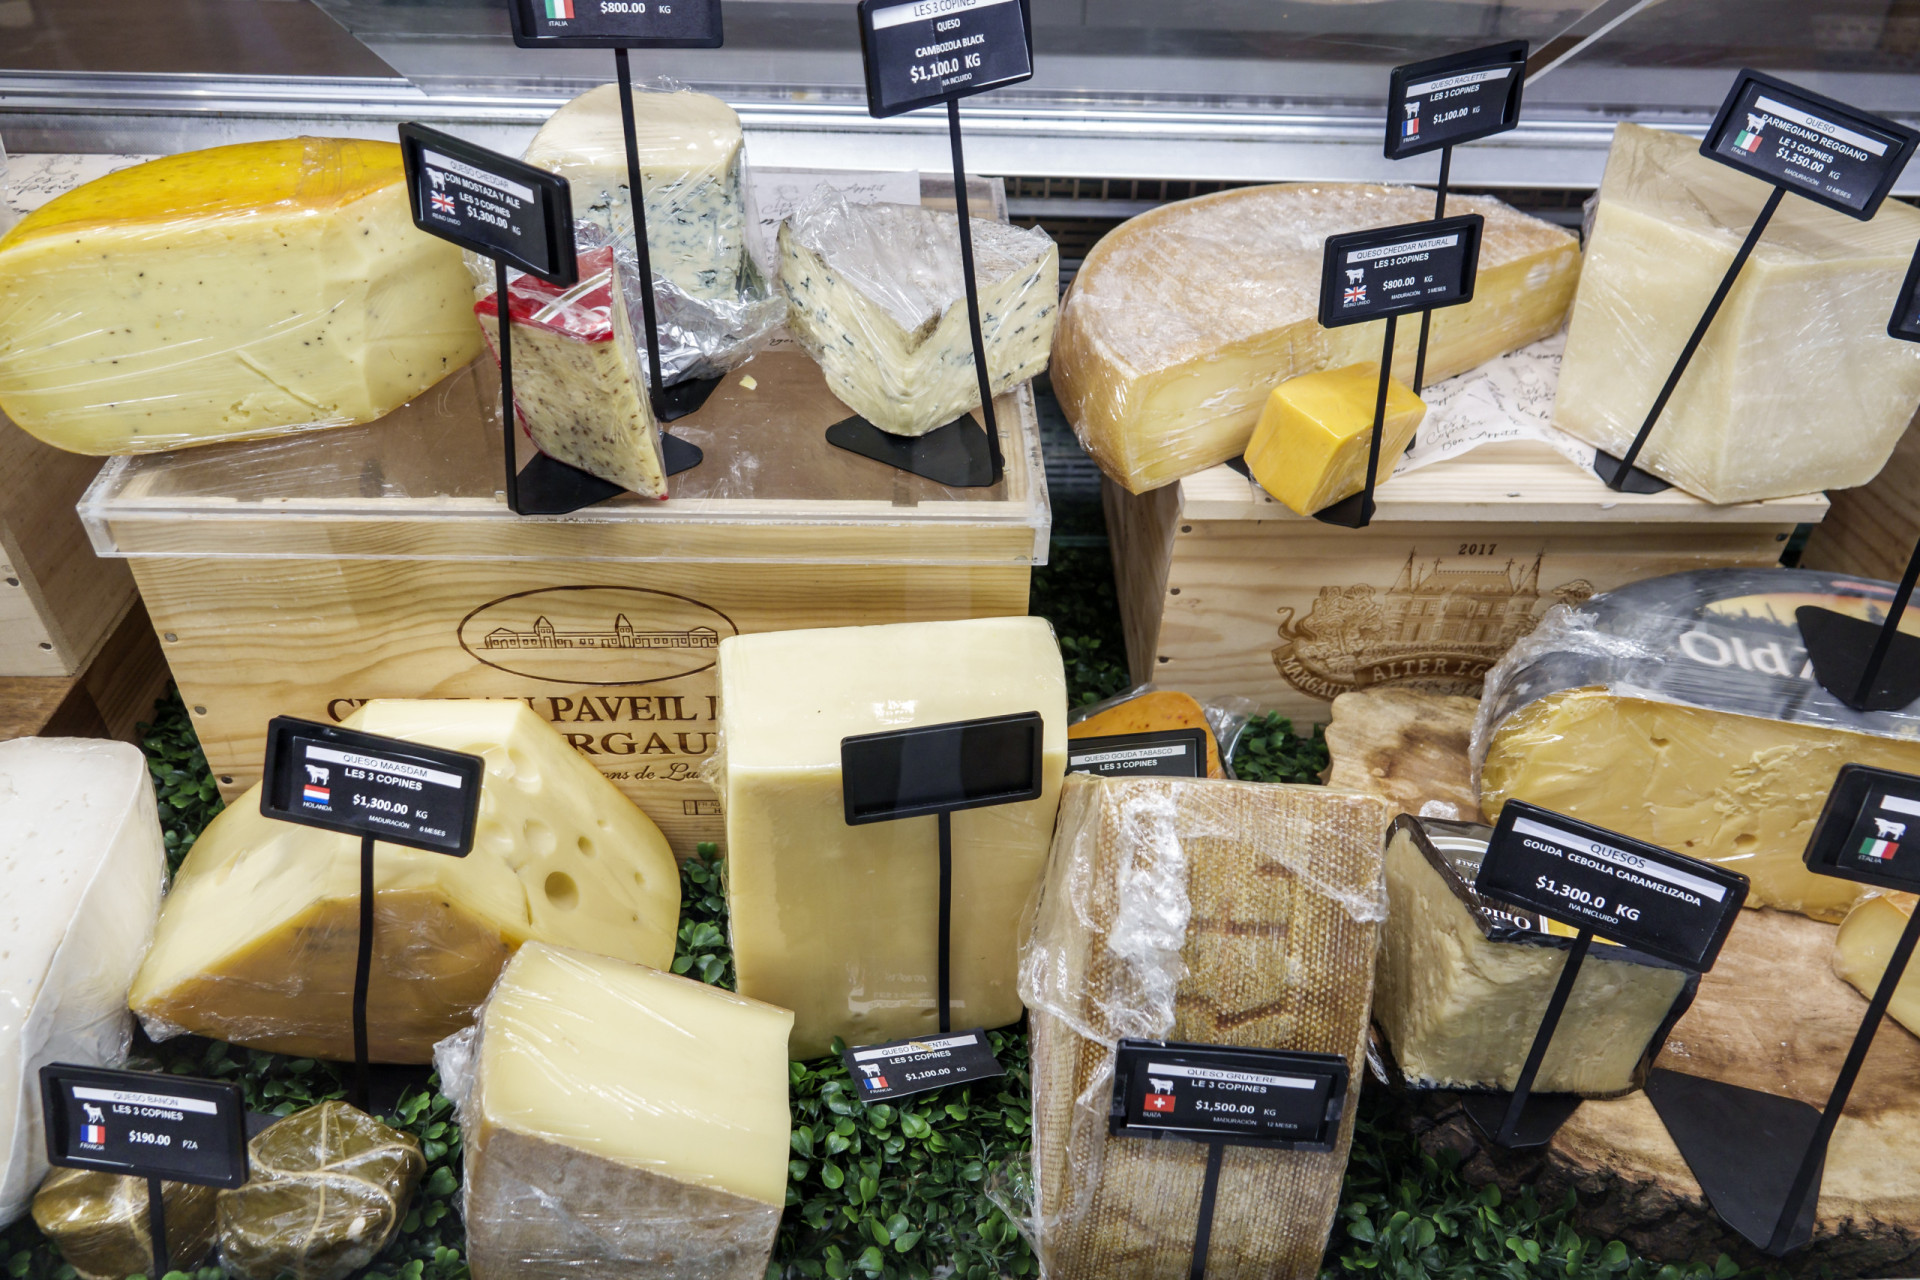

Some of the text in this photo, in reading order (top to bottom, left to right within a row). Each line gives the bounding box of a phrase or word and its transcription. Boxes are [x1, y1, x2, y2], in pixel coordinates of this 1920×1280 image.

[600, 2, 645, 14] $800.00
[914, 0, 976, 16] LES 3 COPINES
[937, 18, 960, 31] QUESO
[915, 34, 985, 57] CAMBOZOLA BLACK
[910, 53, 981, 83] $1,100.0 KG
[951, 73, 972, 84] INCLUIDO
[1431, 72, 1488, 90] QUESO RACLETTE
[1430, 92, 1444, 102] LES
[1450, 84, 1480, 96] COPINES
[1433, 108, 1468, 124] $1,100.00
[1805, 117, 1835, 134] QUESO
[1403, 135, 1420, 143] FRANCIA
[1762, 114, 1868, 162] PARMEGIANO REGGIANO
[1731, 147, 1747, 157] ITALIA
[1779, 136, 1834, 163] LE 3 COPINES
[1776, 147, 1841, 180] $1,350.00 KG
[450, 161, 509, 189] QUESO CHEDDAR
[1784, 168, 1819, 186] MADURACIÓN
[1832, 187, 1852, 199] MESES
[444, 172, 521, 209] CON MOSTAZA Y ALE
[459, 192, 511, 218] LES 3 COPINES
[432, 212, 461, 226] REINO UNIDO
[467, 205, 521, 235] $1,300.00 KG
[1357, 238, 1449, 259] QUESO CHEDDAR NATURAL
[1374, 260, 1389, 269] LES
[1396, 253, 1429, 265] COPINES
[1383, 277, 1415, 291] $800.00
[1391, 290, 1421, 300] MADURACIÓN
[1458, 543, 1498, 556] 2017
[1680, 630, 1793, 678] Old
[1372, 658, 1487, 681] ALTER EG
[547, 696, 697, 722] PAVEIL
[562, 732, 716, 755] RGAU
[1085, 748, 1173, 762] QUESO GOUDA TABASCO
[343, 754, 428, 778] QUESO MAASDAM
[635, 766, 655, 780] de
[660, 763, 700, 781] Lu
[1100, 763, 1115, 771] LES
[1123, 759, 1157, 768] COPINES
[345, 767, 423, 791] LES 3 COPINES
[303, 802, 333, 812] HOLANDA
[353, 794, 428, 820] $1,300.00 KG
[369, 815, 410, 829] MADURACIÓN
[424, 826, 446, 837] MESES
[1456, 859, 1480, 869] DALE
[1590, 844, 1646, 869] QUESOS
[1858, 855, 1882, 864] ITALIA
[1523, 838, 1701, 907] GOUDA CEBOLLA CARAMELIZADA
[1536, 875, 1641, 921] $1,300.0 KG
[1481, 906, 1531, 930] Onio
[1568, 902, 1618, 924] IVA INCLUIDO
[881, 1039, 951, 1056] QUESO EMENTAL
[914, 1050, 951, 1061] COPINES
[905, 1068, 950, 1082] $1,100.00
[1187, 1069, 1276, 1084] QUESO GRUYERE
[1191, 1079, 1267, 1094] LE 3 COPINES
[113, 1091, 146, 1102] QUESO
[112, 1104, 184, 1121] LES 3 COPINES
[1195, 1100, 1255, 1114] $1,500.00
[80, 1142, 105, 1151] FRANCIA
[128, 1130, 198, 1150] $190.00 PZA
